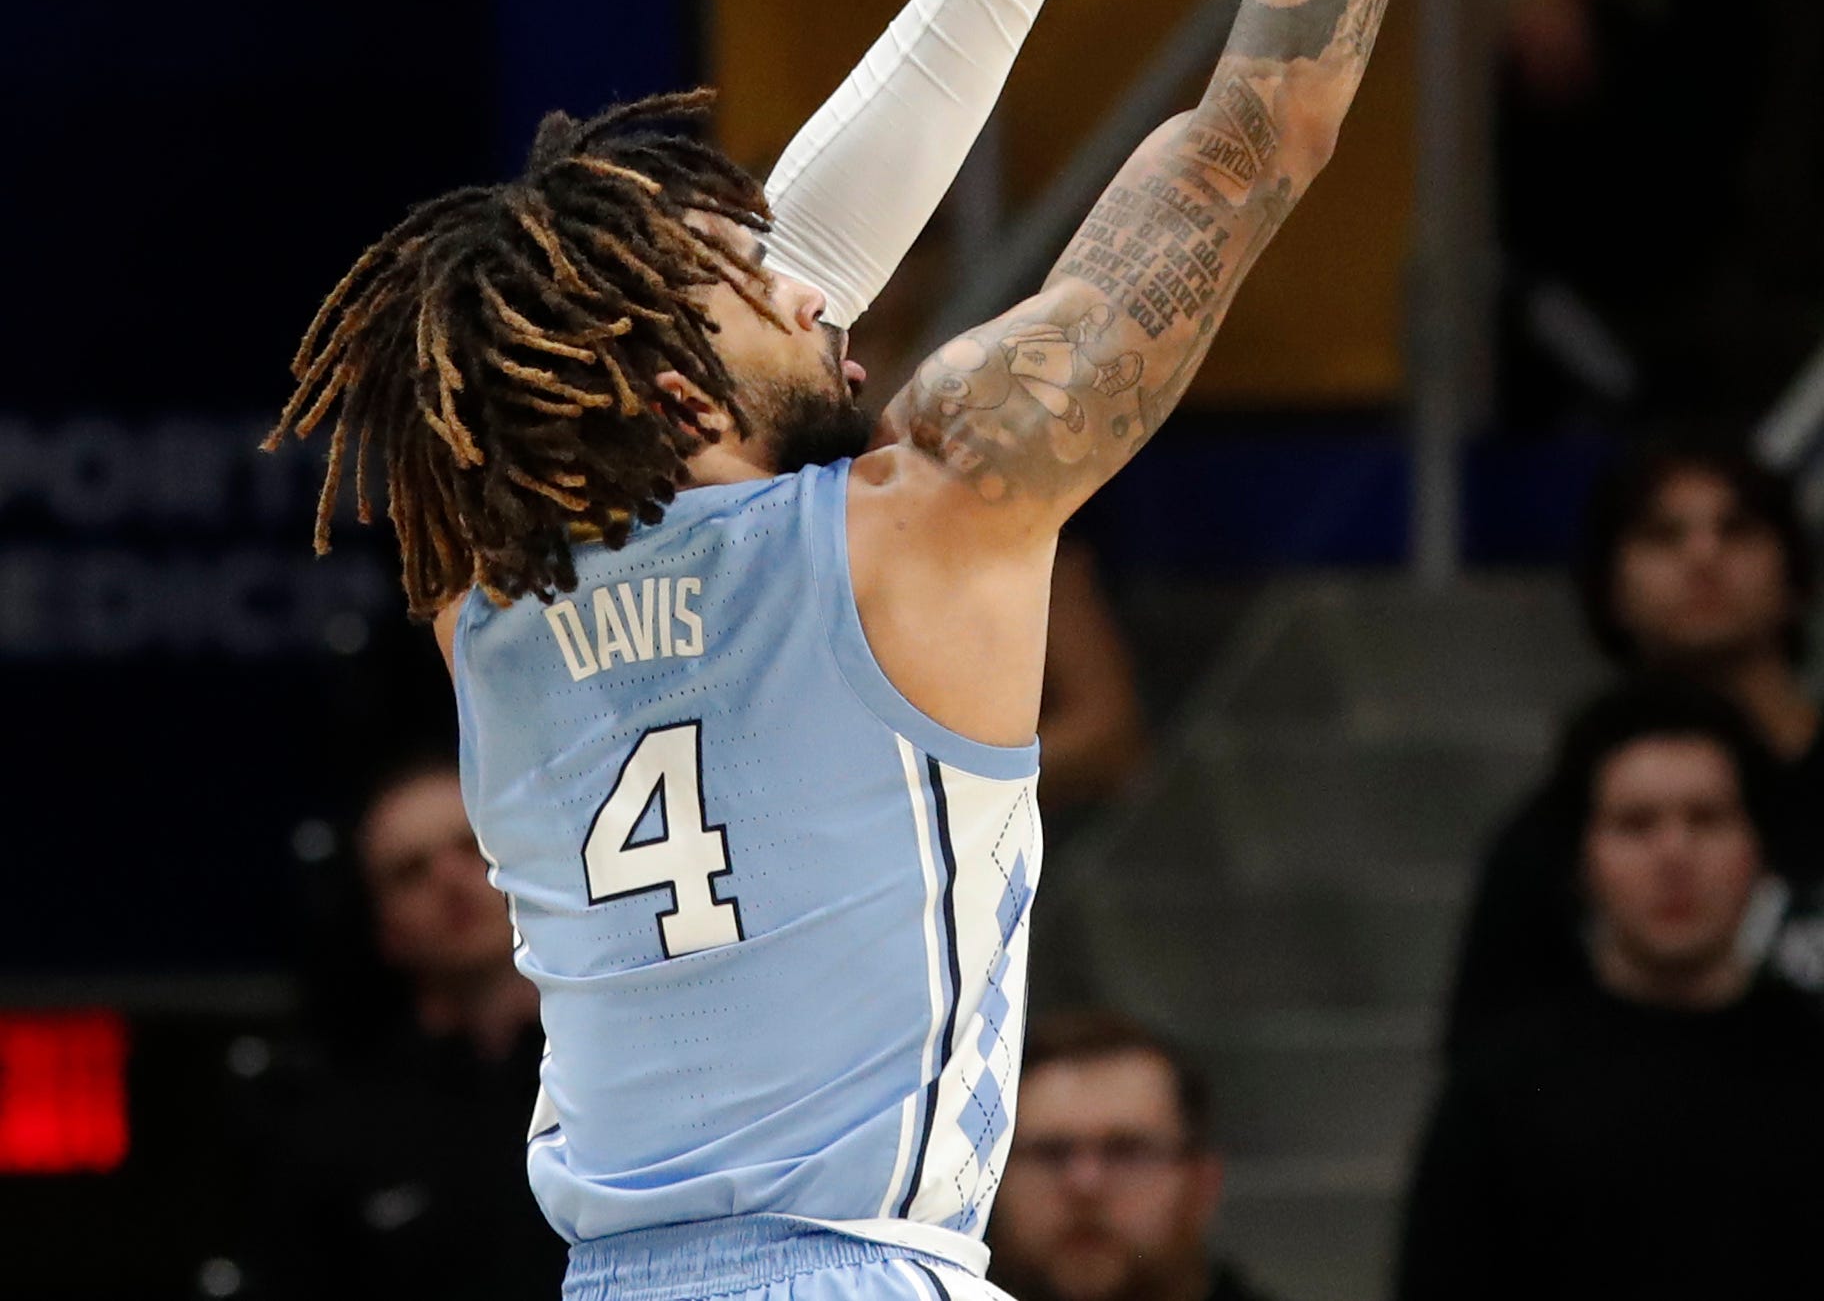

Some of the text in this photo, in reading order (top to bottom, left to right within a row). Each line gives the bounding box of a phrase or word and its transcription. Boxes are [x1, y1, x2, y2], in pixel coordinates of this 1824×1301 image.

[1197, 133, 1255, 181] STUART
[1080, 222, 1199, 320] HAVE FOR YOU
[1084, 245, 1145, 288] PLANS
[1190, 240, 1225, 282] YOU
[1126, 297, 1165, 340] FOR
[1141, 281, 1179, 325] THE
[544, 577, 704, 682] DAVIS
[581, 719, 745, 959] 4
